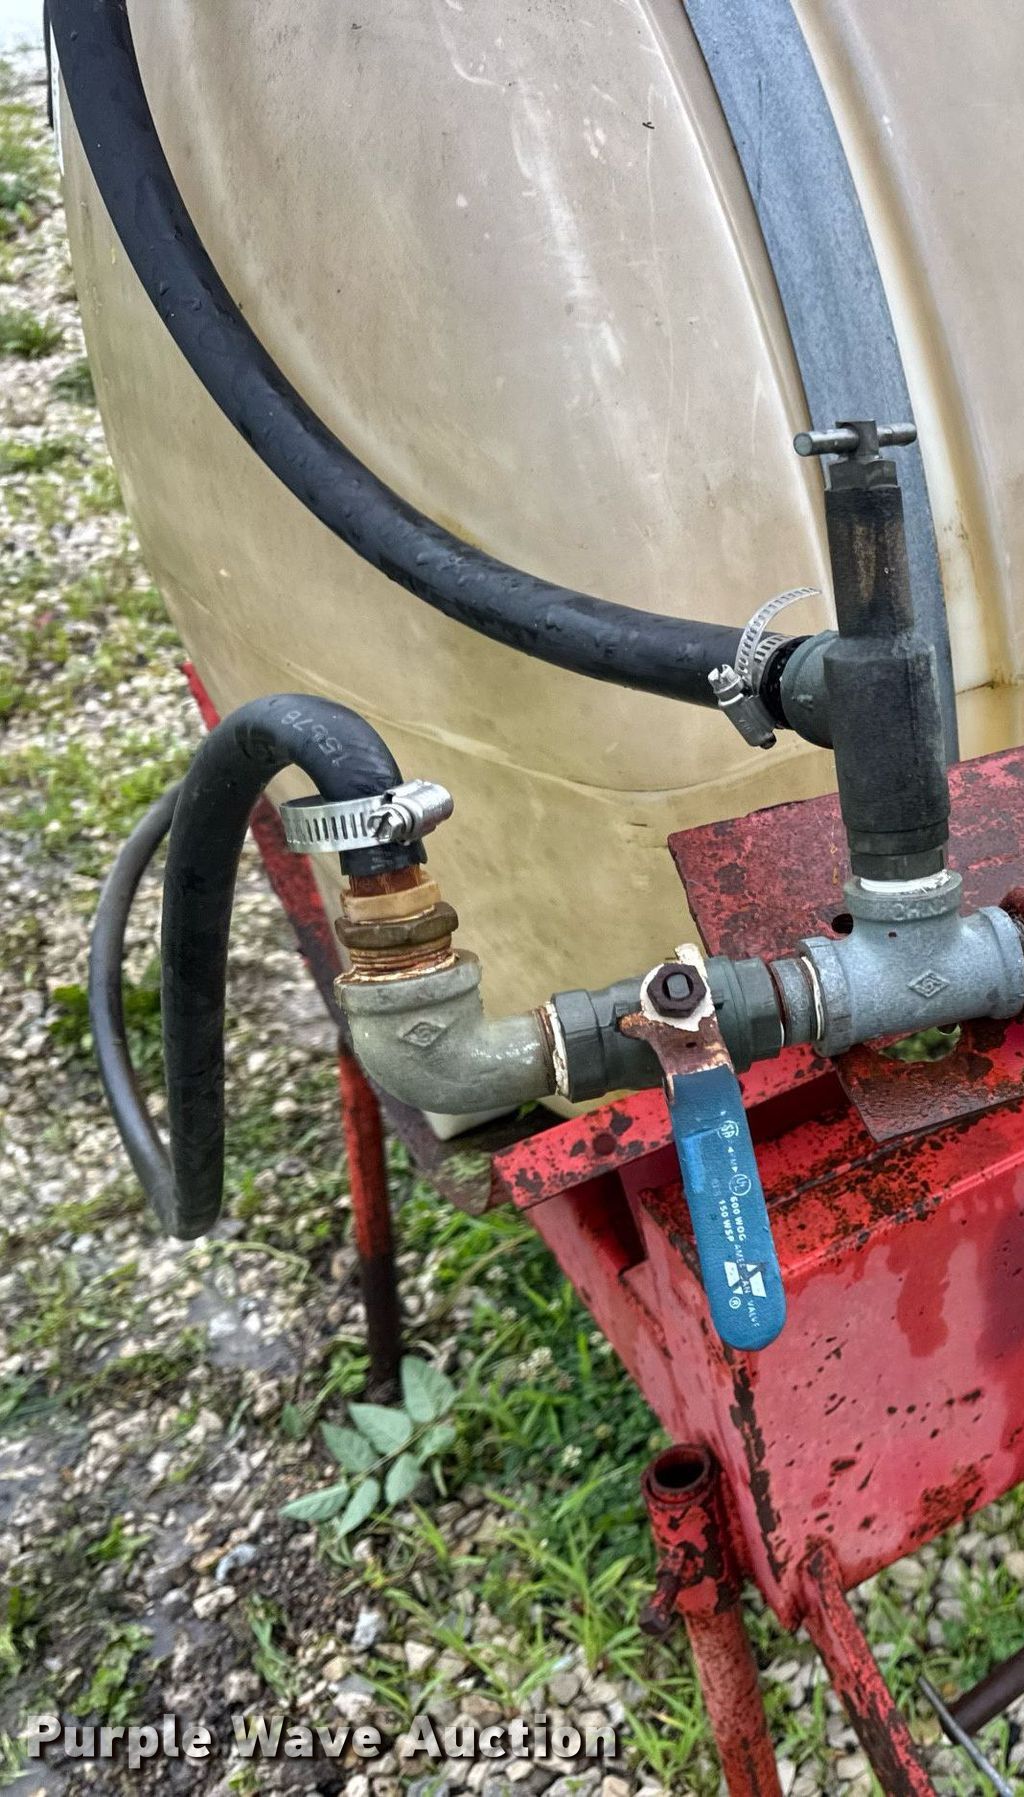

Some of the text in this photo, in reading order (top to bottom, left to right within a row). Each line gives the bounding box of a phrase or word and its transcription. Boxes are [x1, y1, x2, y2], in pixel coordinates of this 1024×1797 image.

[719, 1199, 735, 1242] 150 WSP
[730, 1196, 747, 1241] 600 WOG
